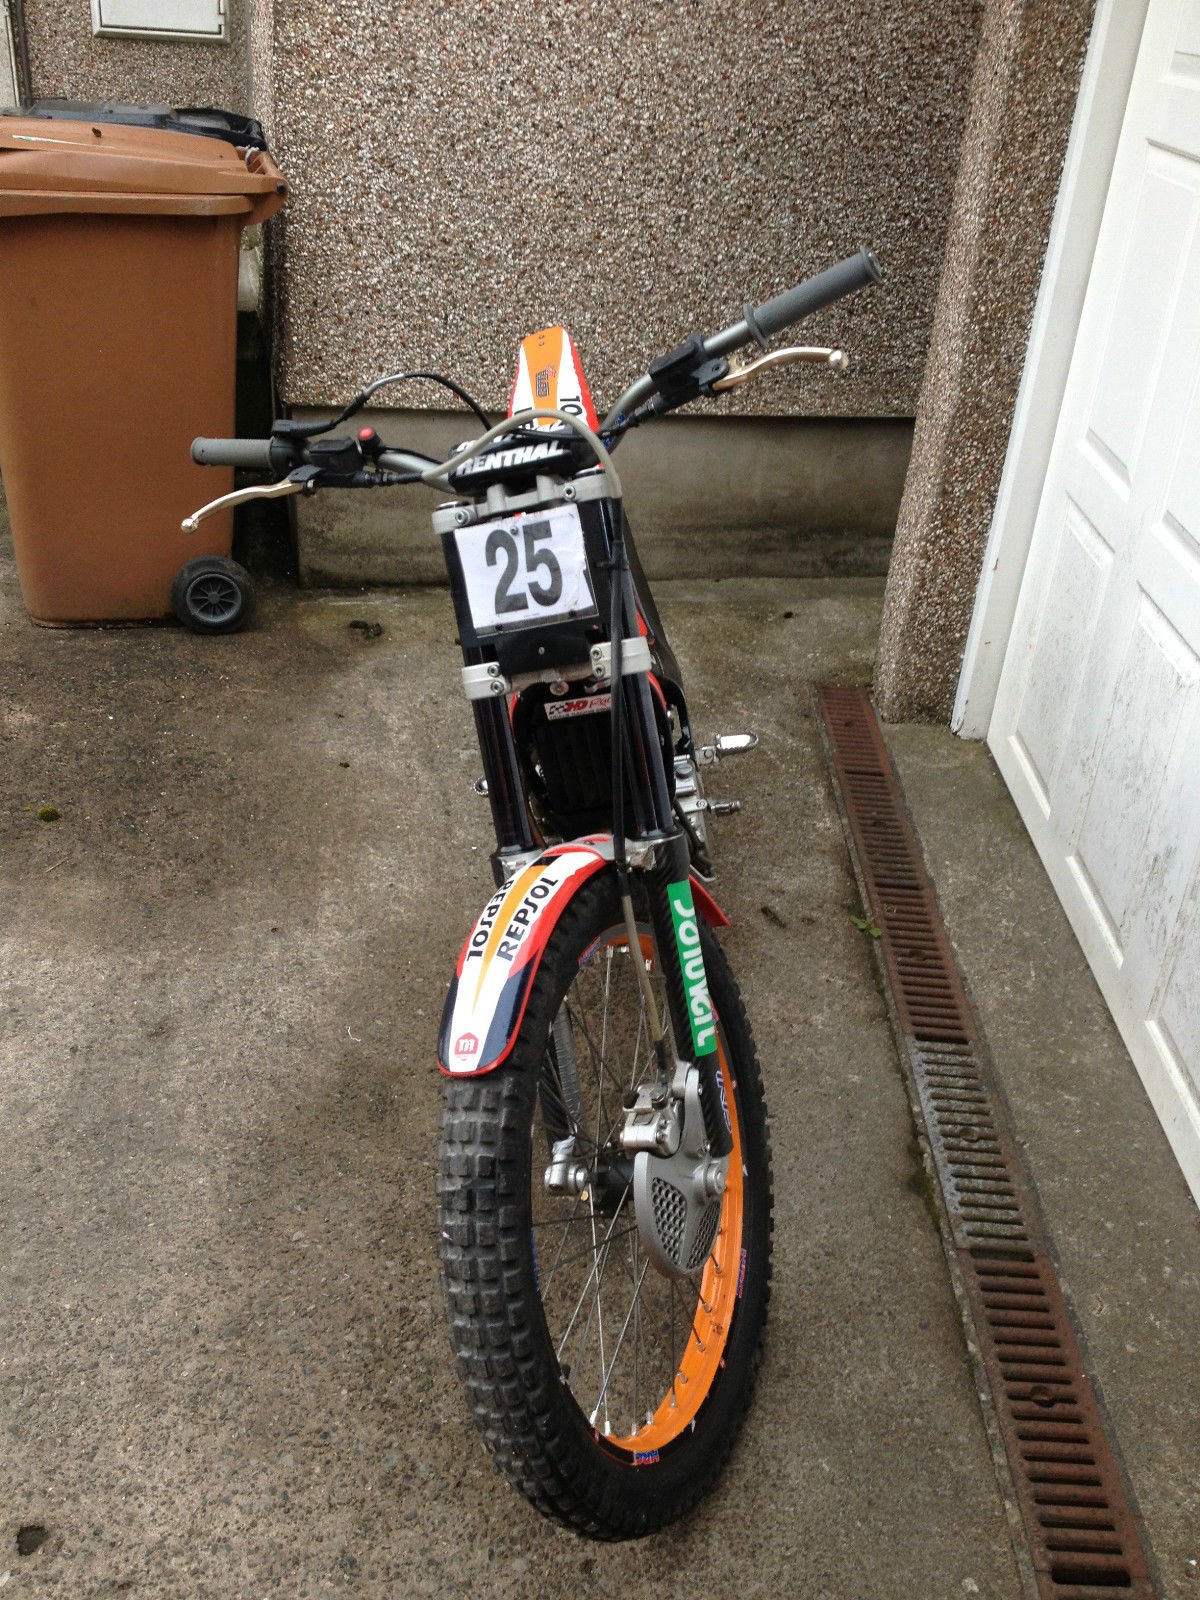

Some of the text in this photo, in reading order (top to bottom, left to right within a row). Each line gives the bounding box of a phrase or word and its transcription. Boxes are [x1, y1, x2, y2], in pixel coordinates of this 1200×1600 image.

[456, 440, 565, 476] RENTHAL
[485, 520, 563, 614] 25
[496, 876, 559, 962] REPSOL
